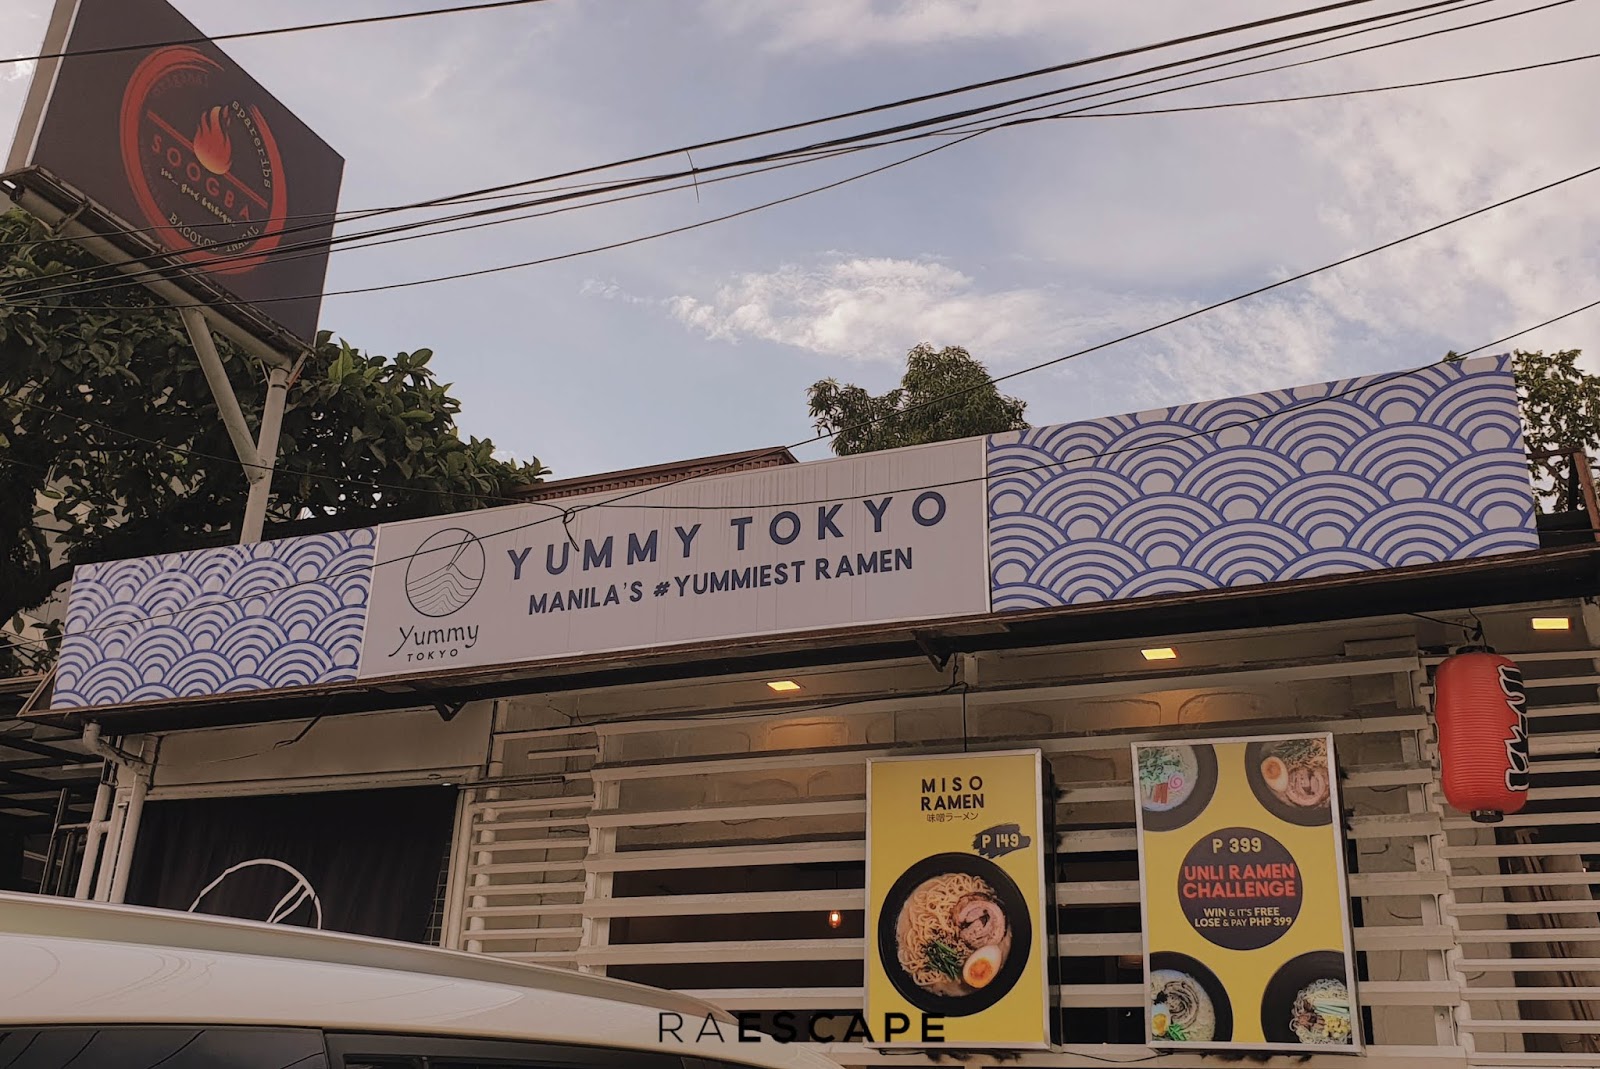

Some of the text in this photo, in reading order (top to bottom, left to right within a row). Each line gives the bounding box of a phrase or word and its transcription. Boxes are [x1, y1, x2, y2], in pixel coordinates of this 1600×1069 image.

[231, 100, 272, 189] spareribs
[151, 135, 251, 221] SOOGBA
[507, 491, 947, 580] YUMMY TOKYO
[528, 547, 913, 616] MANILA'S #YUMMIEST RAMEN
[388, 624, 479, 657] Yummy
[407, 648, 458, 662] TOKYO
[921, 775, 983, 793] MISO
[921, 793, 984, 811] RAMEN
[926, 811, 979, 823] 味噌ラーメン
[981, 833, 1019, 848] P 149
[1212, 837, 1262, 854] P 399
[1184, 863, 1295, 880] UNLI RAMEN
[1183, 880, 1296, 898] CHALLENGE
[1203, 907, 1280, 917] WIN & IT'S FREE
[1194, 916, 1292, 927] LOSE & PAY PHP 399
